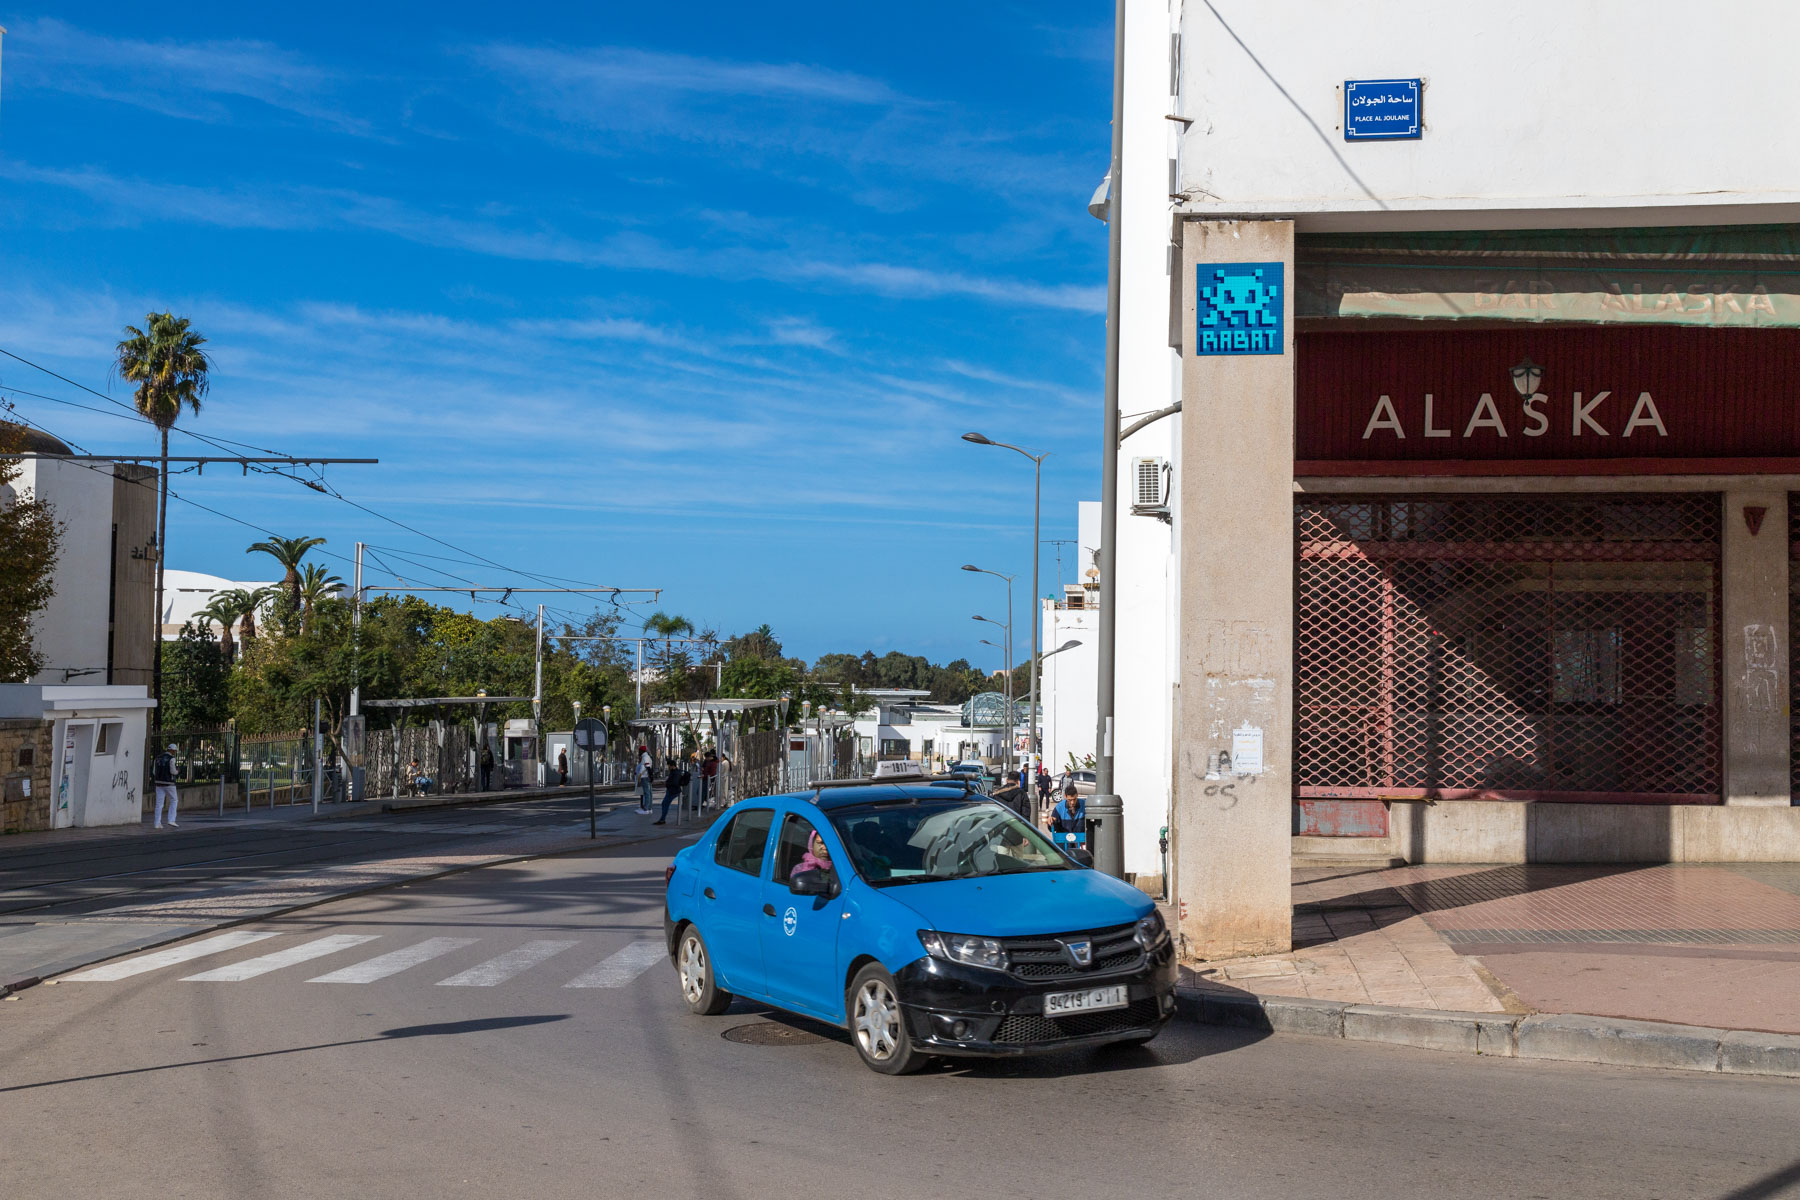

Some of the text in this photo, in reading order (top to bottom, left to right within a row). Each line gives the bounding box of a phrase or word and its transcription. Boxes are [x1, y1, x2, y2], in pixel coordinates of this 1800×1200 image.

[1352, 94, 1413, 106] ساحة الجولان
[1600, 283, 1776, 316] ALASKA
[1202, 329, 1277, 349] RABAT
[1362, 391, 1669, 439] ALASKA
